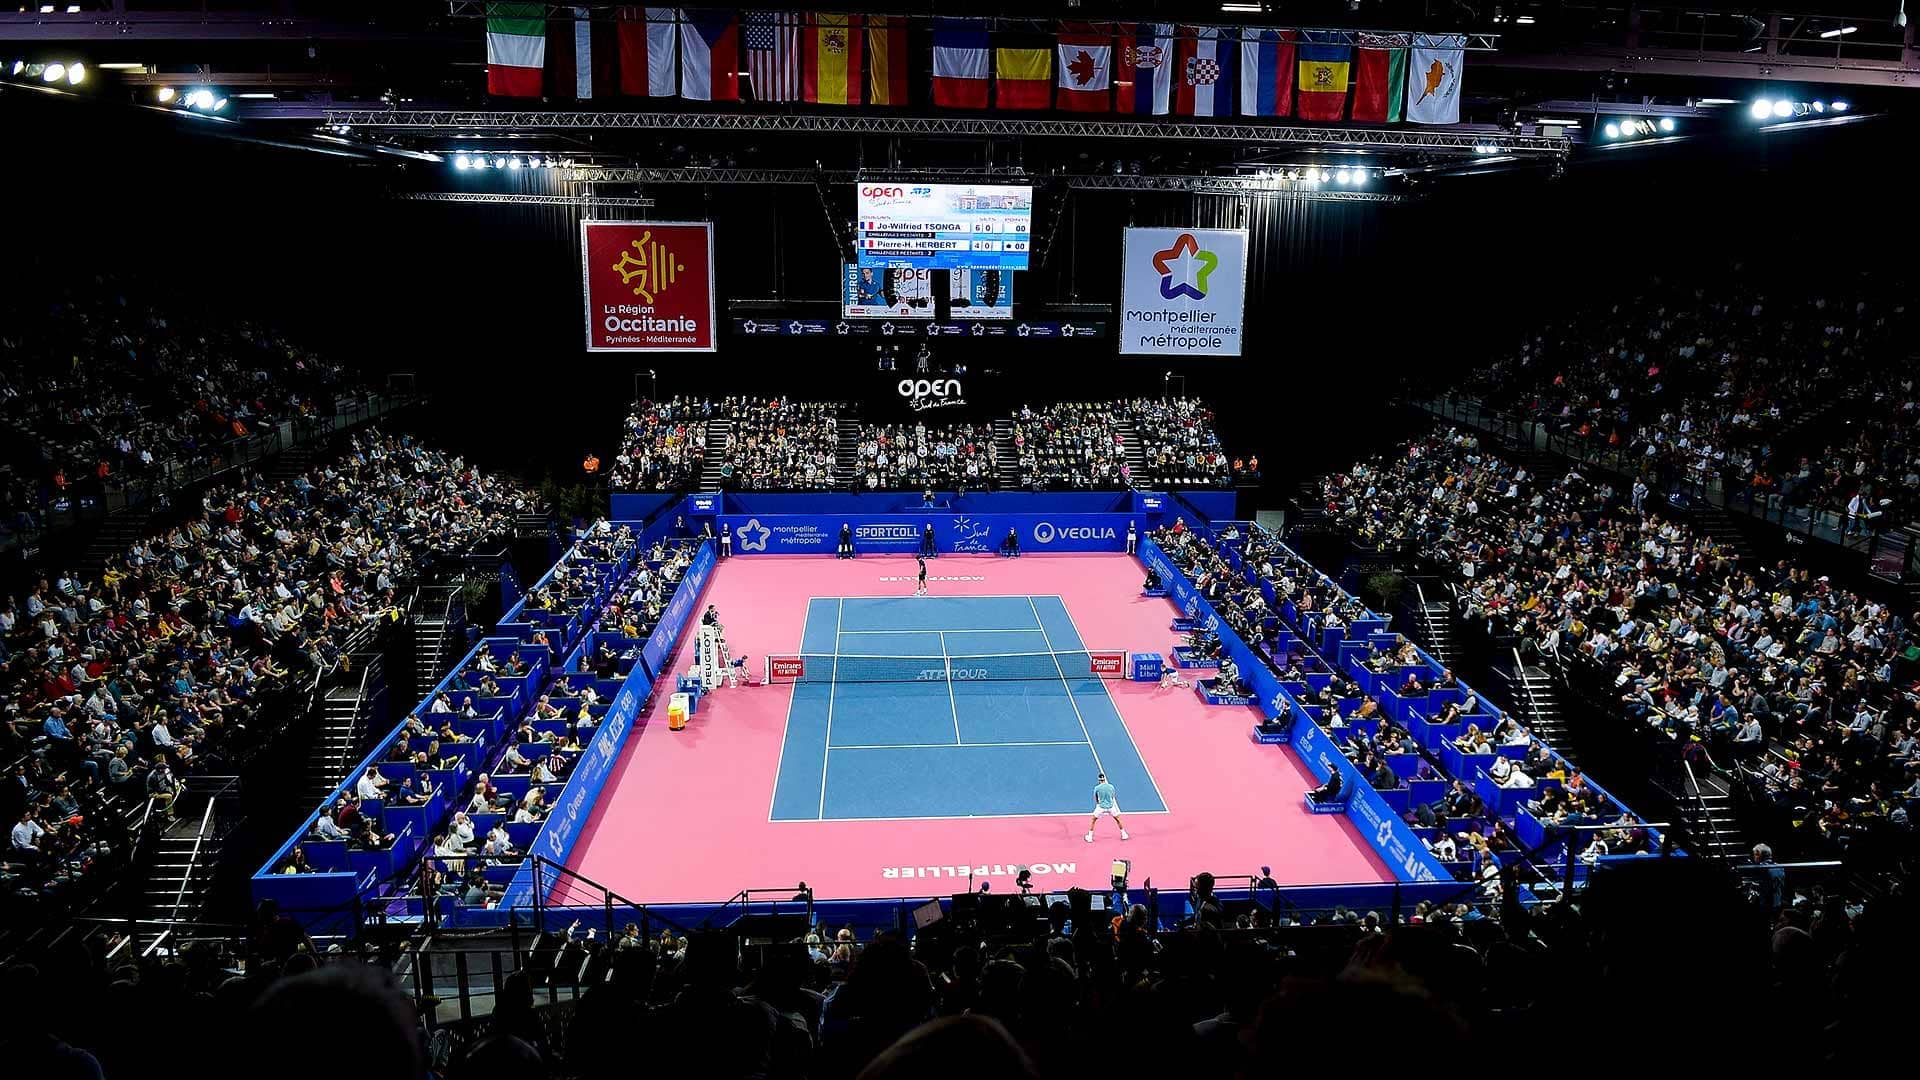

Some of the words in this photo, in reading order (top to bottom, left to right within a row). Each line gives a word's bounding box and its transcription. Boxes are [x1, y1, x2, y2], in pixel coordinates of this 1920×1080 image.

[878, 222, 921, 230] Jo-Wilfried
[604, 305, 616, 314] La
[619, 304, 654, 315] Région
[605, 316, 696, 332] Occitanie
[1171, 324, 1237, 334] méditerranée
[606, 335, 640, 344] Pyrénées
[940, 398, 967, 407] France
[856, 528, 920, 537] SPORTCOLL
[965, 522, 990, 539] Sud
[1058, 527, 1116, 539] VEOLIA
[954, 540, 989, 552] France
[704, 632, 712, 685] PEUGEOT
[916, 669, 946, 680] ATP
[950, 669, 987, 679] TOUR
